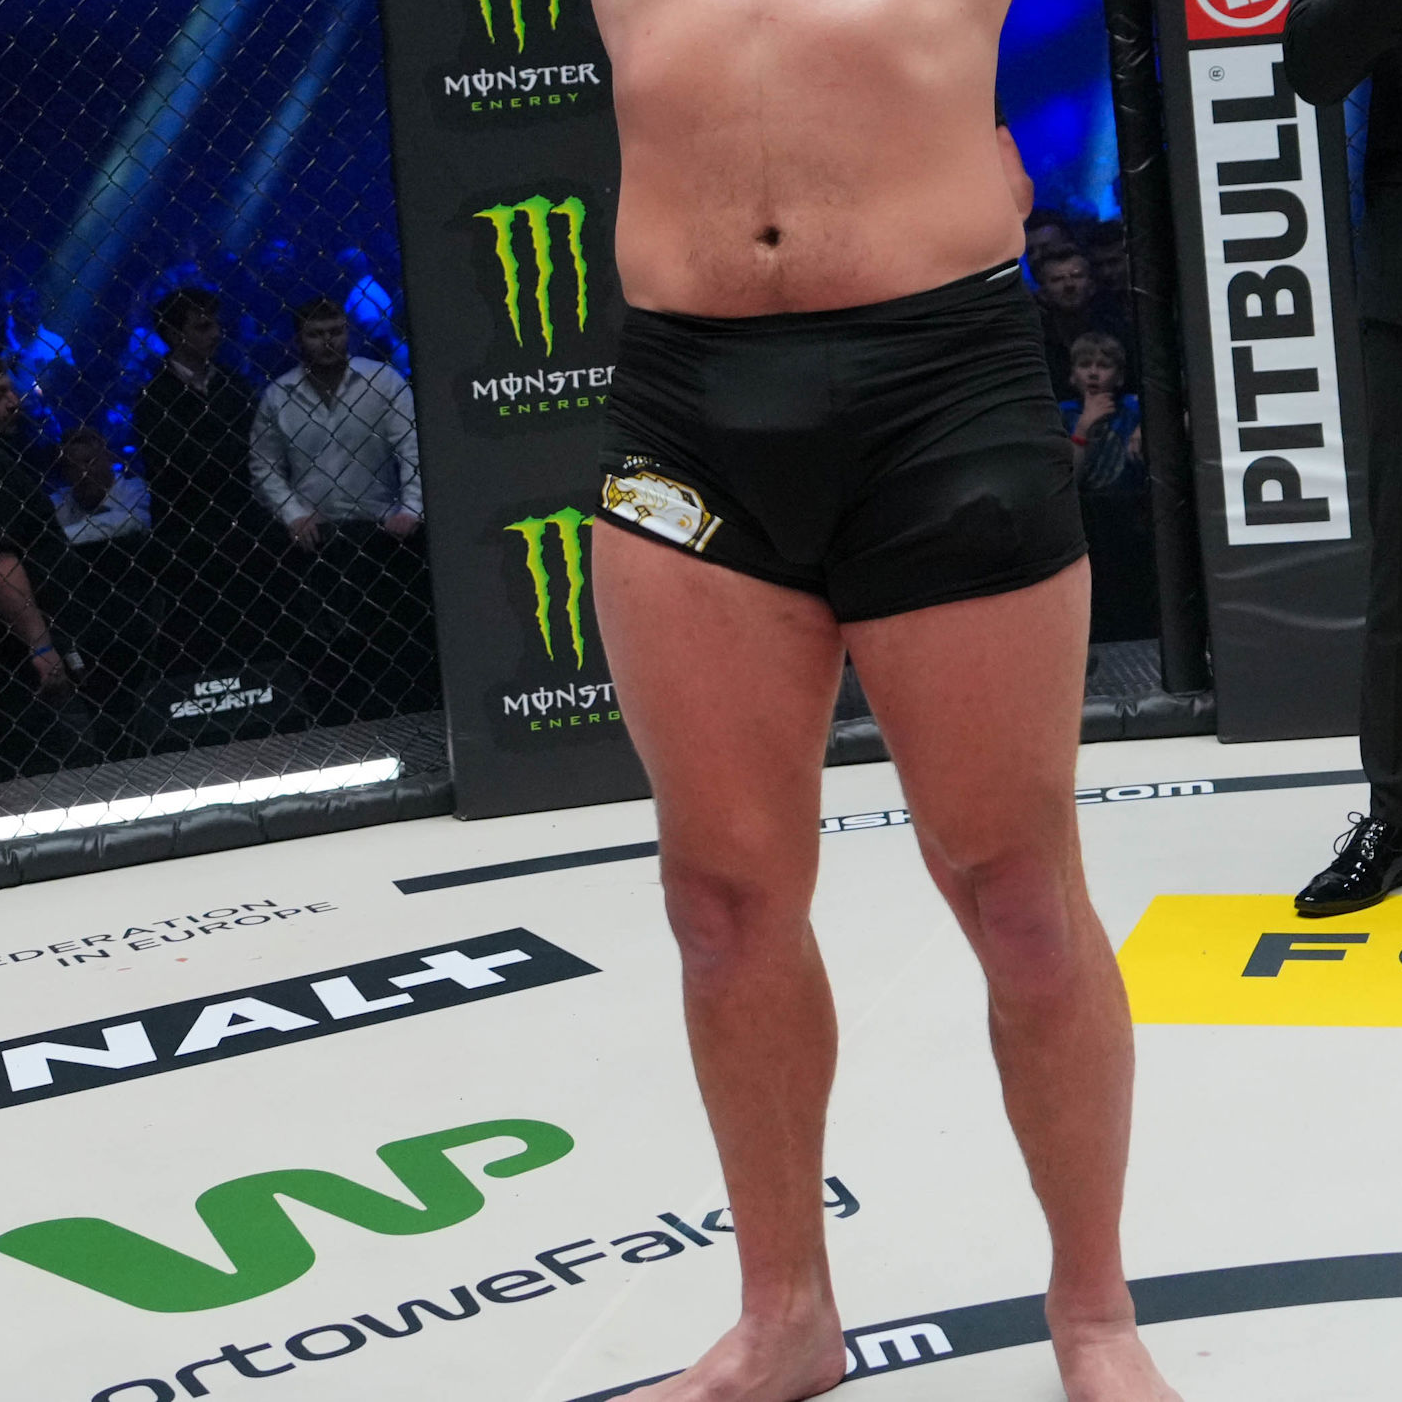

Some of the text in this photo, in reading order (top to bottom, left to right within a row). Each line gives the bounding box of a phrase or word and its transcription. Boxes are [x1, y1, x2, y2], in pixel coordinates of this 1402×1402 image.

[471, 92, 580, 112] ENERGY
[499, 394, 608, 417] ENERGY
[193, 677, 241, 697] KSW
[169, 687, 274, 719] SECURITY
[503, 682, 616, 717] MONST
[530, 710, 621, 731] ENERG
[56, 901, 339, 968] IN EUROPE
